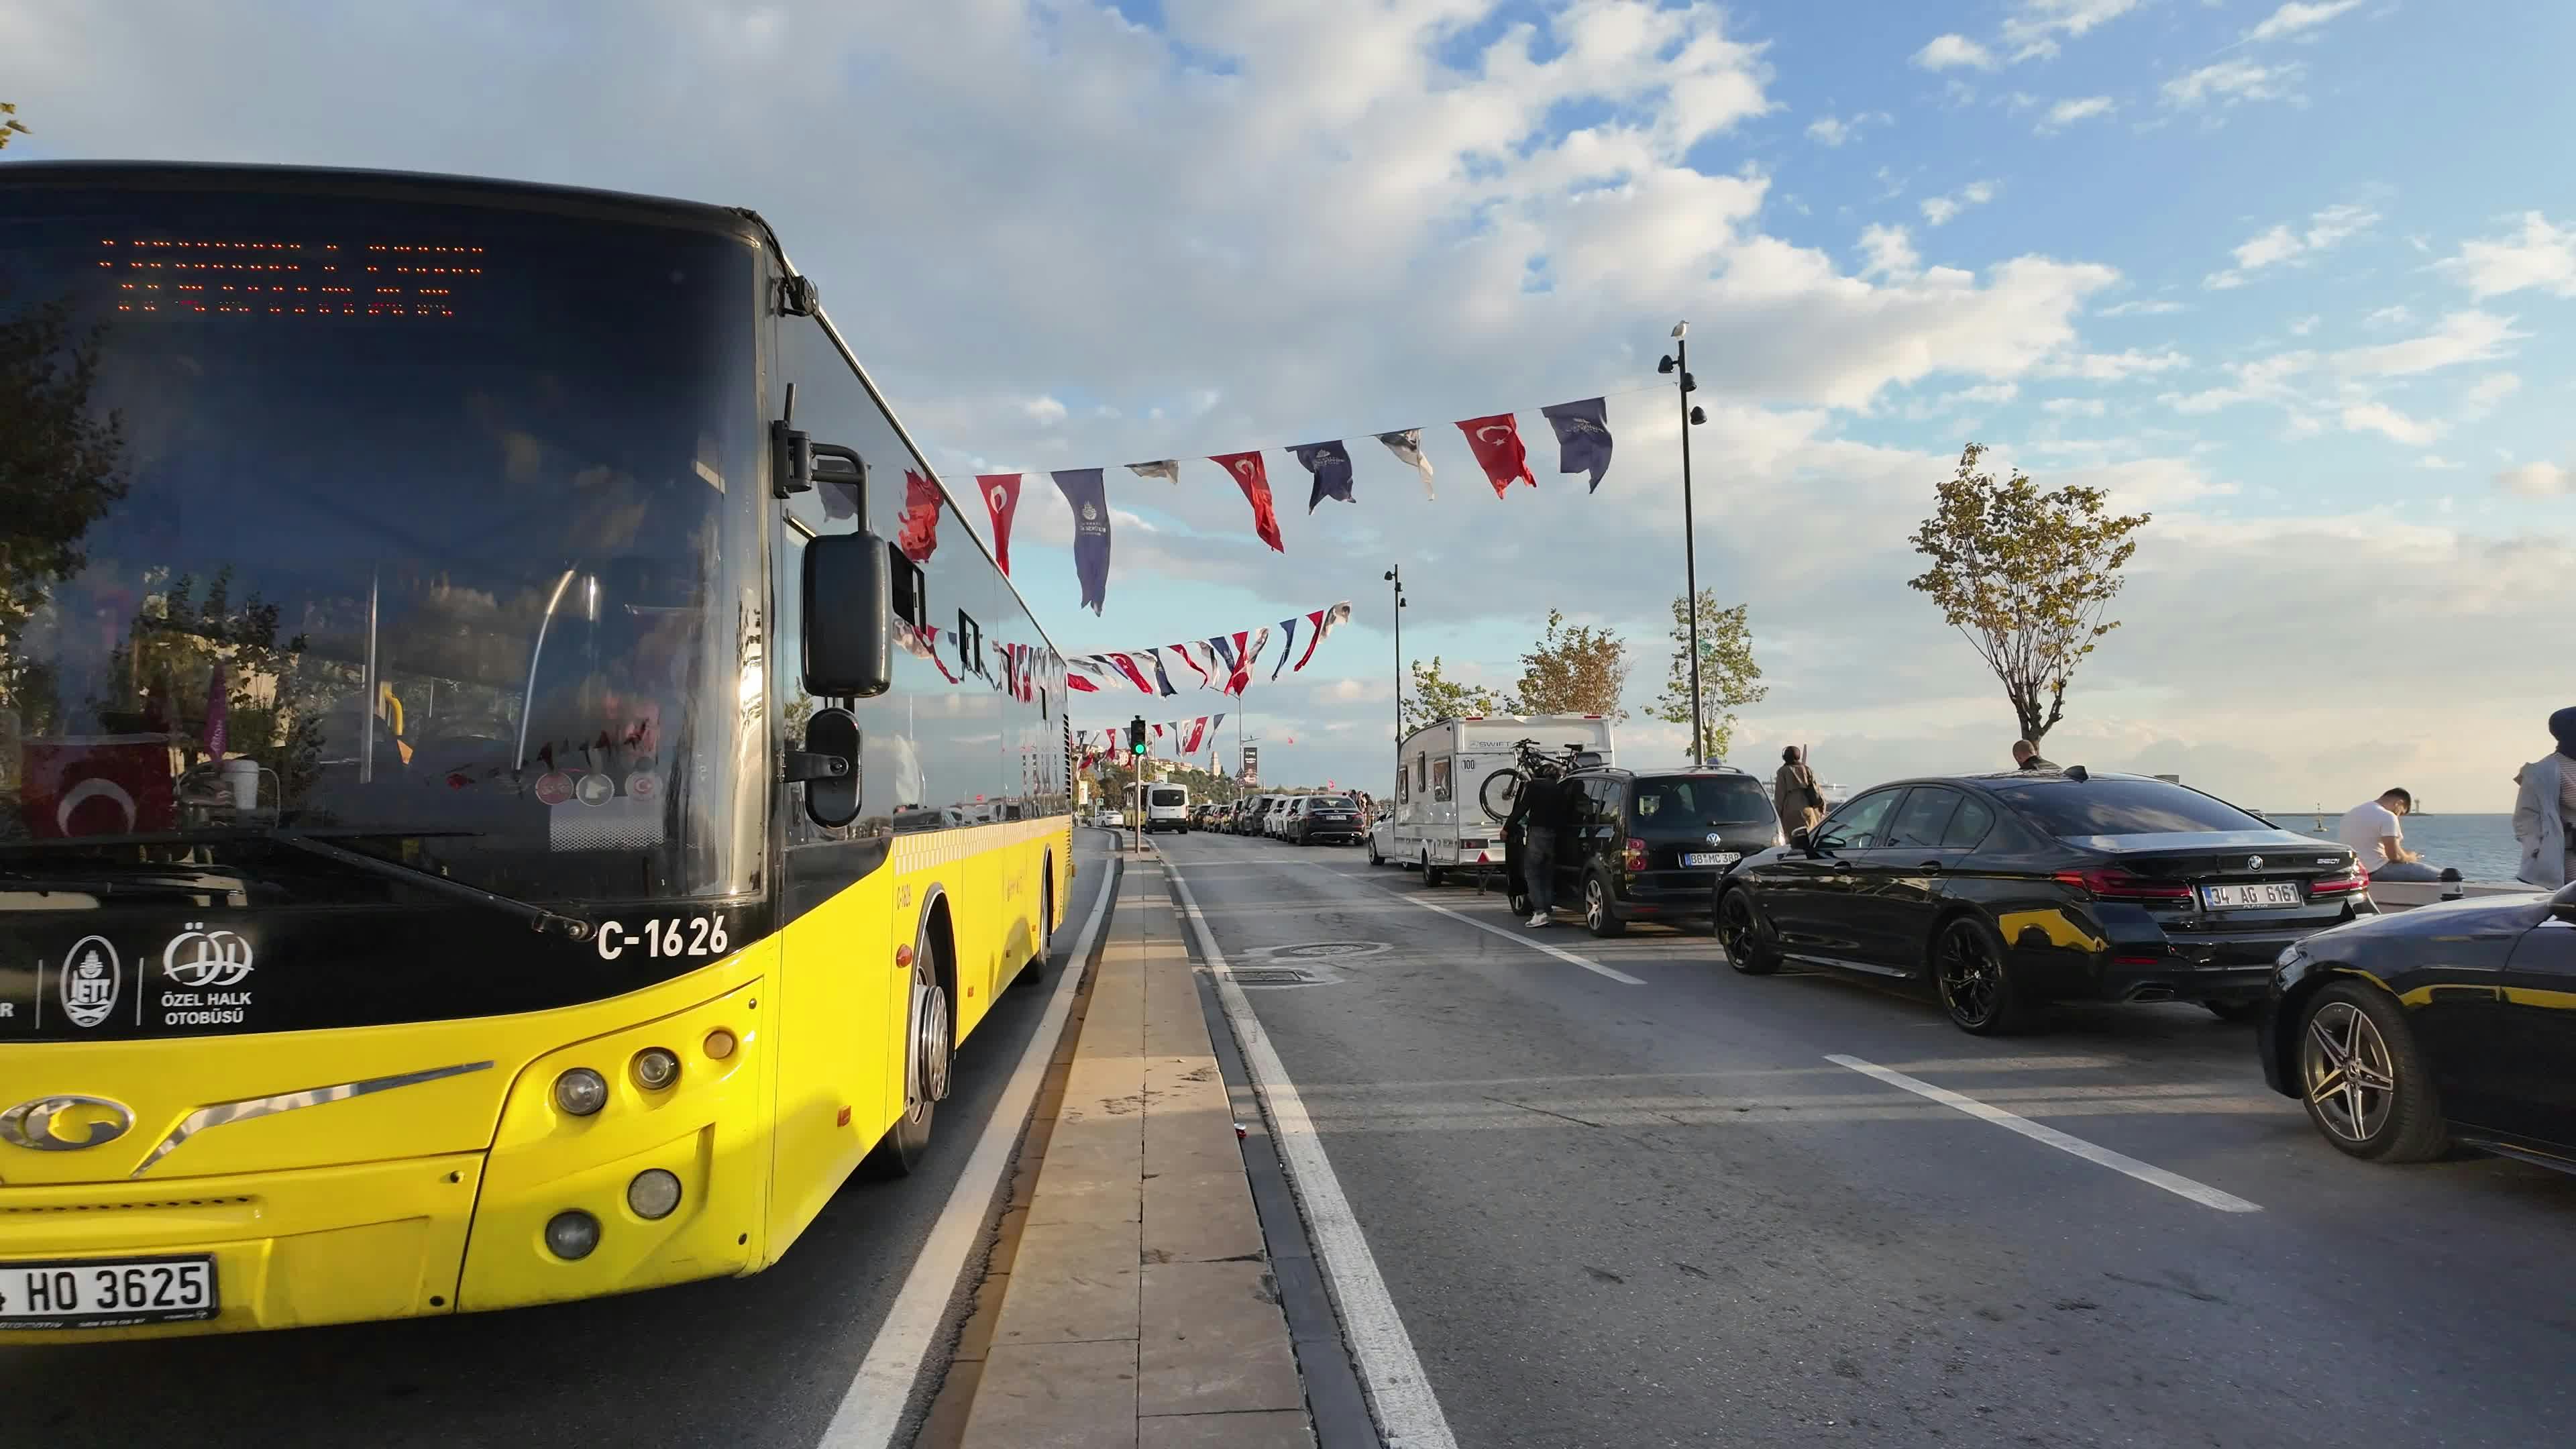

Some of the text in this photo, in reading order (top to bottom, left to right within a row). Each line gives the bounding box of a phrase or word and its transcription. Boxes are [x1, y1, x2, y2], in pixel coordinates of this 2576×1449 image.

[1463, 759, 1475, 770] 100
[1690, 854, 1703, 864] BB
[1709, 854, 1721, 863] MC
[2211, 885, 2299, 905] 34 AG 6161
[598, 914, 728, 960] C-1626
[161, 991, 252, 1008] ÖZEL HALK
[165, 1007, 244, 1025] OTOBÜSÜ
[95, 1266, 202, 1309] 3625
